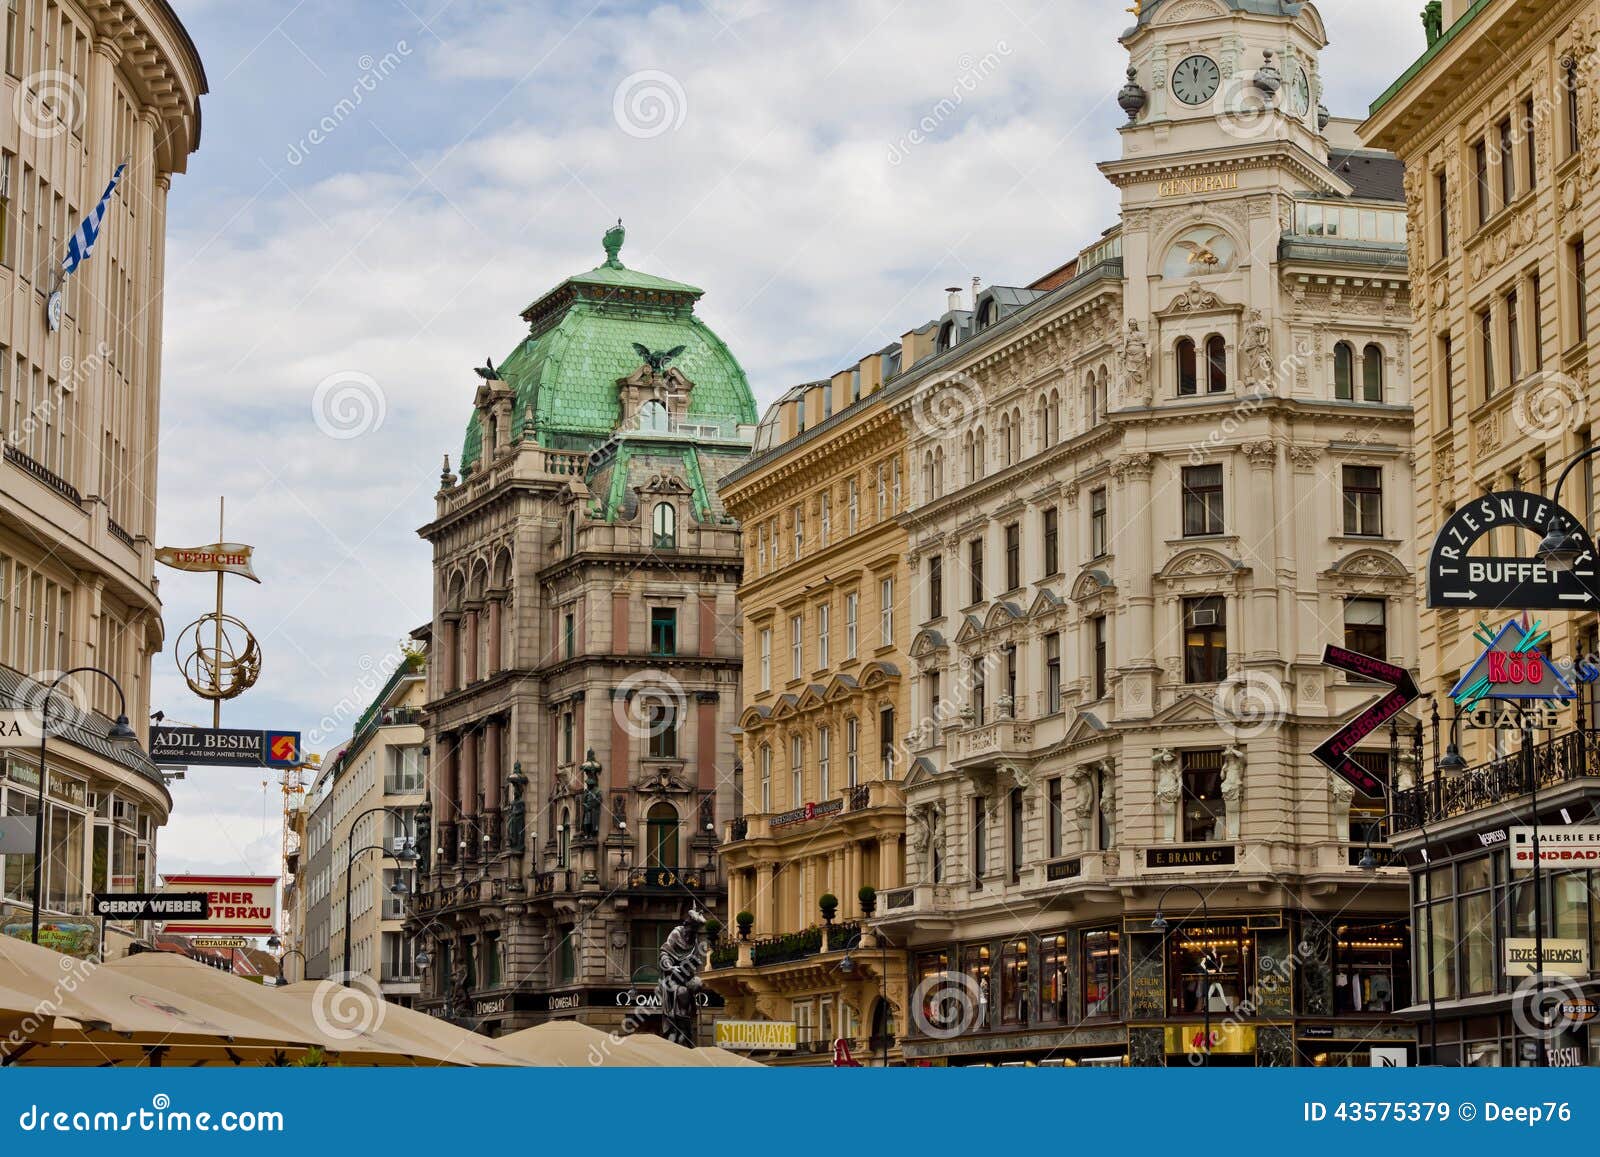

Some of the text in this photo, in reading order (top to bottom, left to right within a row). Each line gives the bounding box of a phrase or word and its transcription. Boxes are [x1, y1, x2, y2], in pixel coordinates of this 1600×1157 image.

[1158, 171, 1238, 197] GENERALI
[1439, 498, 1594, 577] TRZEŚNIEKI
[173, 550, 247, 566] TEPPICHE
[1469, 562, 1558, 584] BUFFET
[1488, 651, 1543, 684] Köö
[1330, 694, 1406, 757] FLEDERMAUS
[153, 732, 261, 749] ADIL BESIM
[1168, 851, 1200, 864] BRAUN
[1517, 849, 1600, 861] SINDBAD
[98, 900, 202, 913] GERRY WEBER
[1509, 948, 1582, 961] TRZEŚNIEWSKI
[482, 1001, 498, 1014] OMEGA
[555, 996, 572, 1008] OMEGA
[1547, 1047, 1580, 1067] FOSSIL
